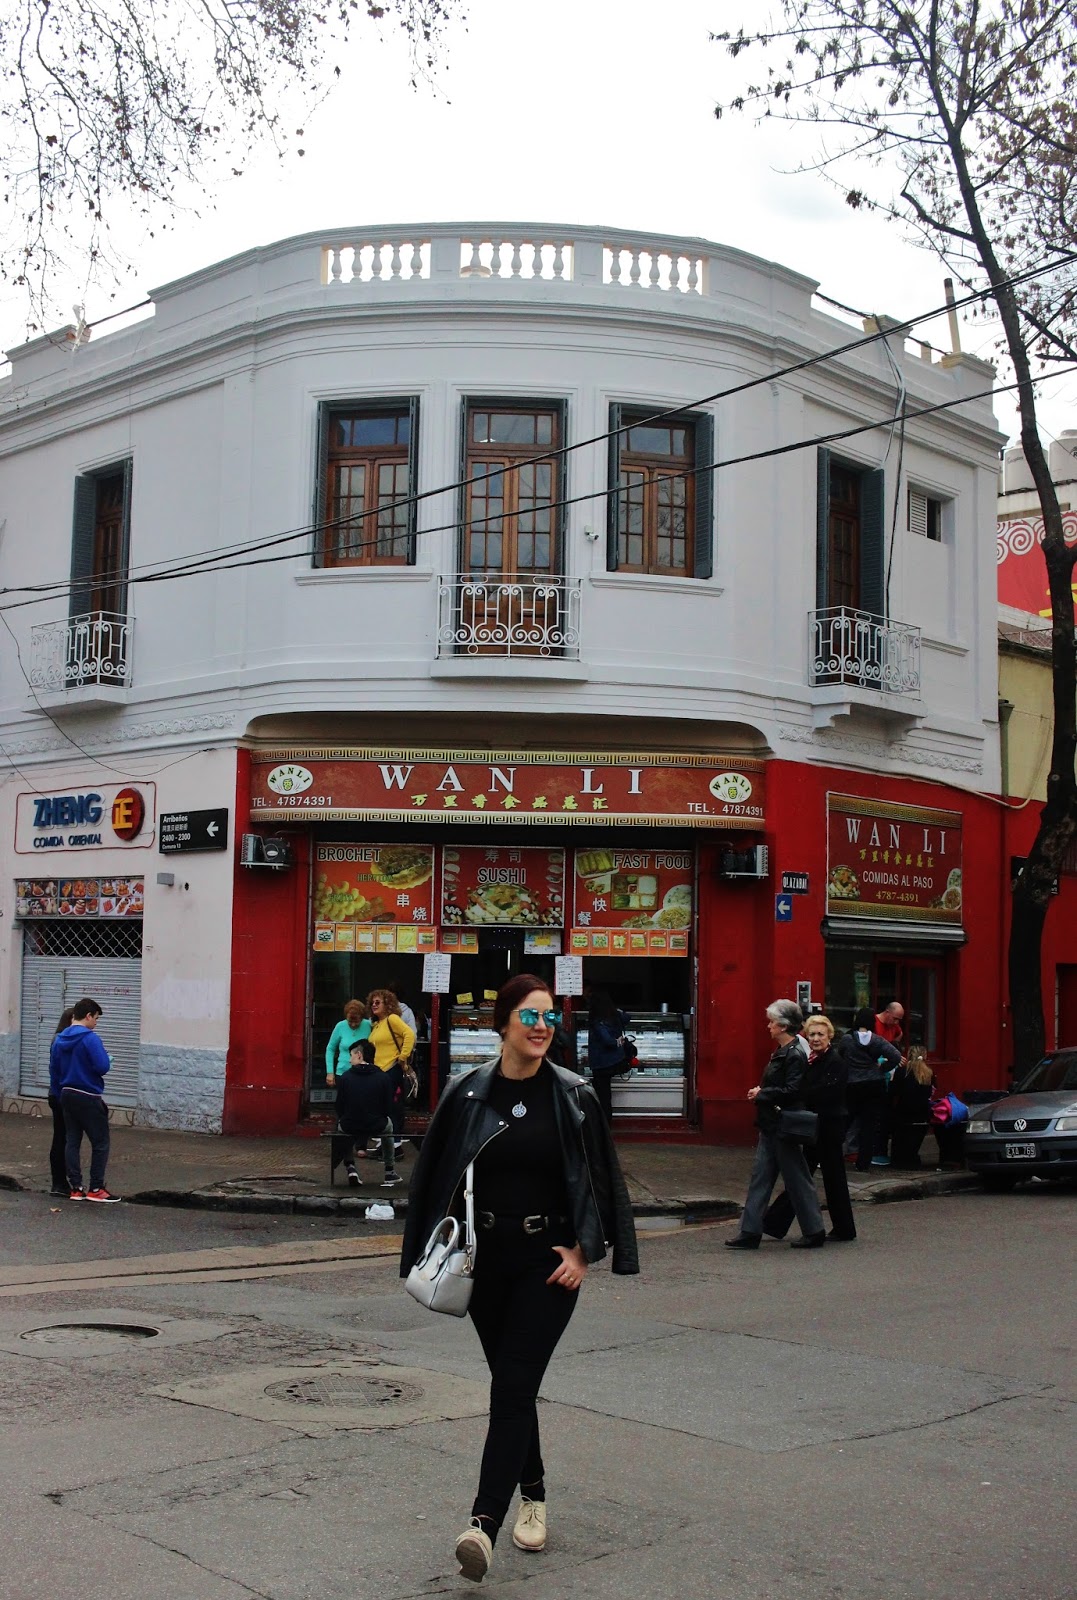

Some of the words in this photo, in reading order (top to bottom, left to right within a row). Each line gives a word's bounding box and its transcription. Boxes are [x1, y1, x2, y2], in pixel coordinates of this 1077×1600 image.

[269, 767, 311, 784] WANLI
[377, 764, 517, 792] WAN
[579, 768, 643, 794] LI
[711, 775, 751, 793] WANLI
[276, 796, 332, 806] 47874391
[33, 793, 102, 827] ZHENG
[722, 804, 763, 816] 47874391
[33, 836, 65, 848] COMIDA
[68, 834, 103, 846] ORIENTAL
[162, 834, 174, 842] 2400
[178, 833, 191, 841] 2300
[846, 818, 900, 849] WAN
[923, 828, 946, 854] LI
[317, 847, 382, 862] BROCHET
[485, 849, 521, 863] 寿司
[613, 853, 651, 869] FAST
[655, 855, 691, 869] FOOD
[477, 867, 526, 884] SUSHI
[862, 870, 899, 885] COMIDAS
[901, 875, 911, 887] AL
[913, 876, 933, 888] PASO
[875, 890, 919, 902] 4787-4391
